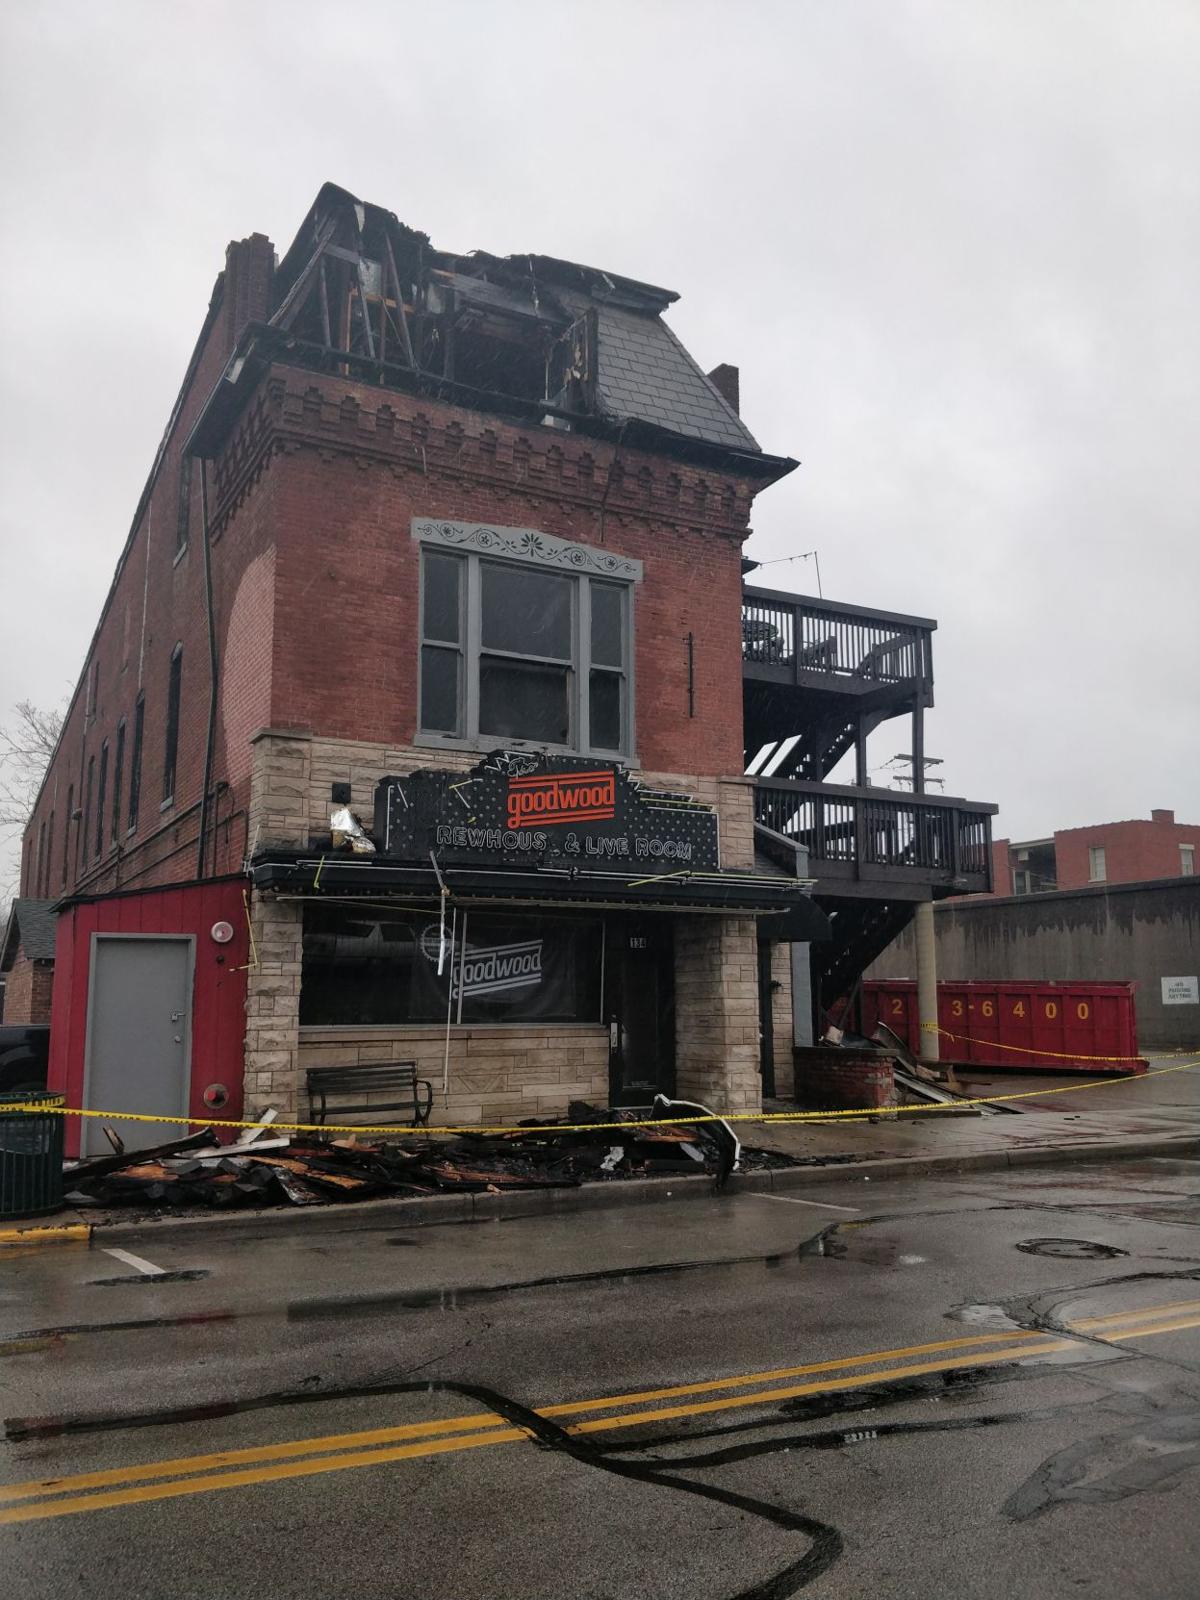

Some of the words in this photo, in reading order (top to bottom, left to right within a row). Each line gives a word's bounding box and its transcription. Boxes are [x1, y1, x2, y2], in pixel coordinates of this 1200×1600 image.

[507, 775, 616, 830] goodwood
[565, 832, 580, 853] &
[586, 835, 630, 856] LIVE
[635, 837, 691, 860] ROOM
